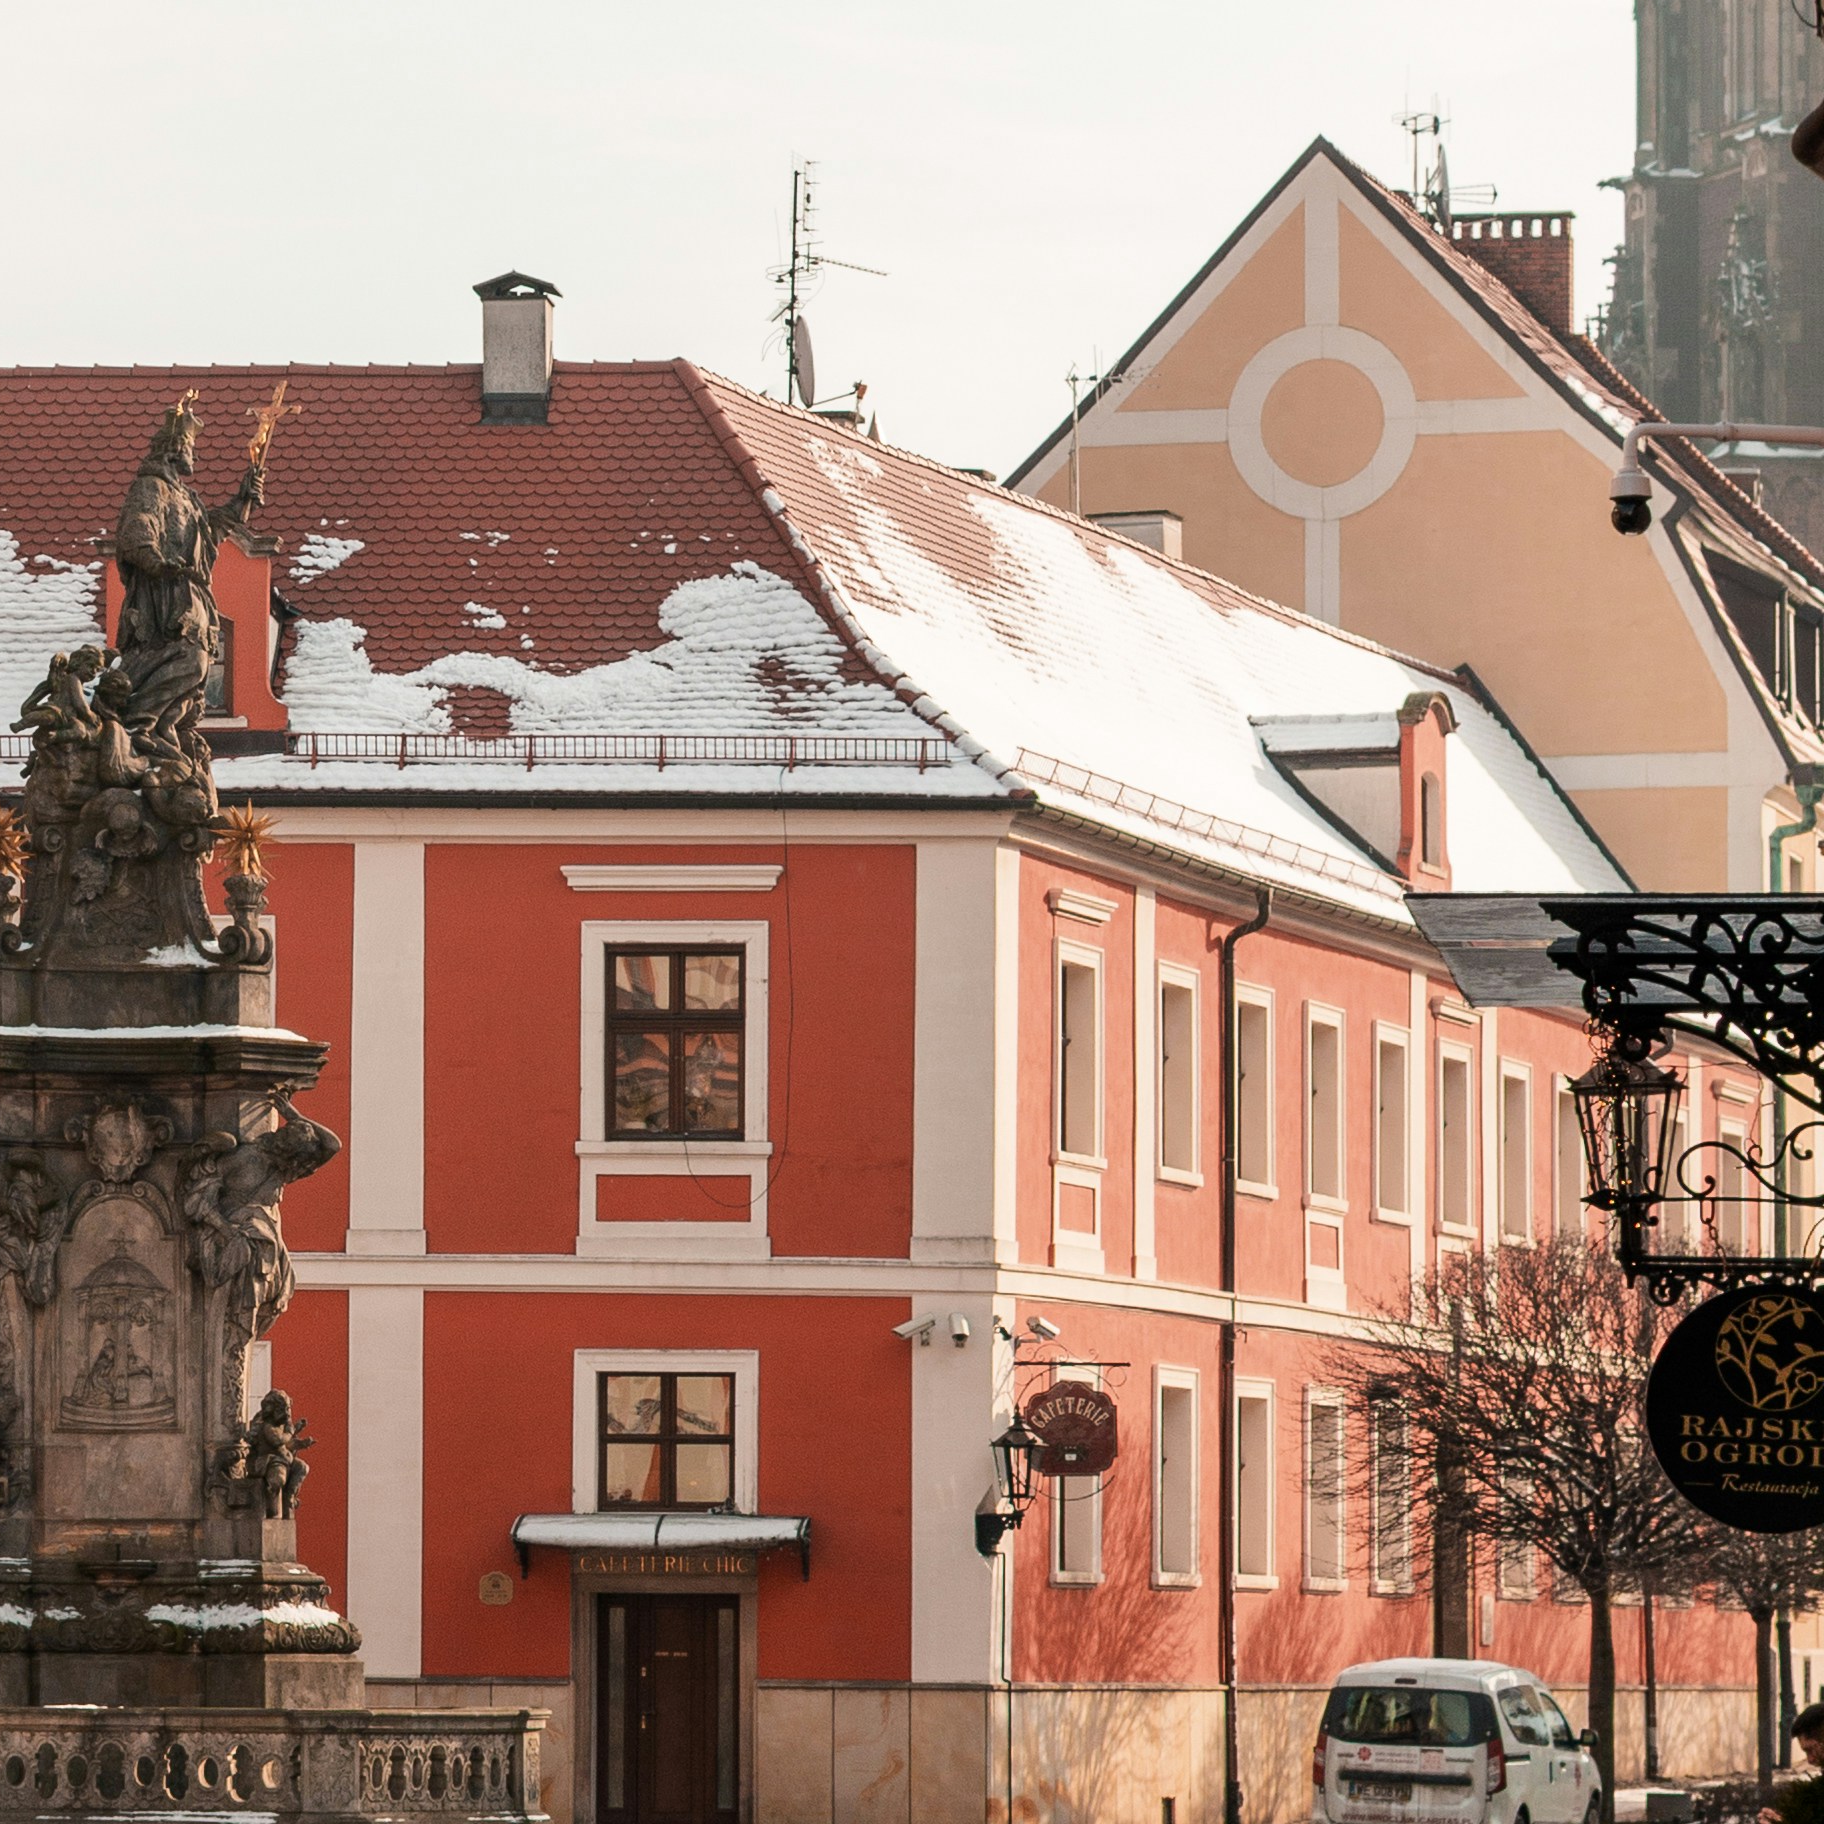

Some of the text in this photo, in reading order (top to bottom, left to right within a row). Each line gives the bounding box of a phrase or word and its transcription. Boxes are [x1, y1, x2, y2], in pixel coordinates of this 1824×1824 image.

[1031, 1397, 1109, 1428] CAFETERIE
[1722, 1473, 1819, 1498] Restauracja
[703, 1556, 749, 1573] CHIC
